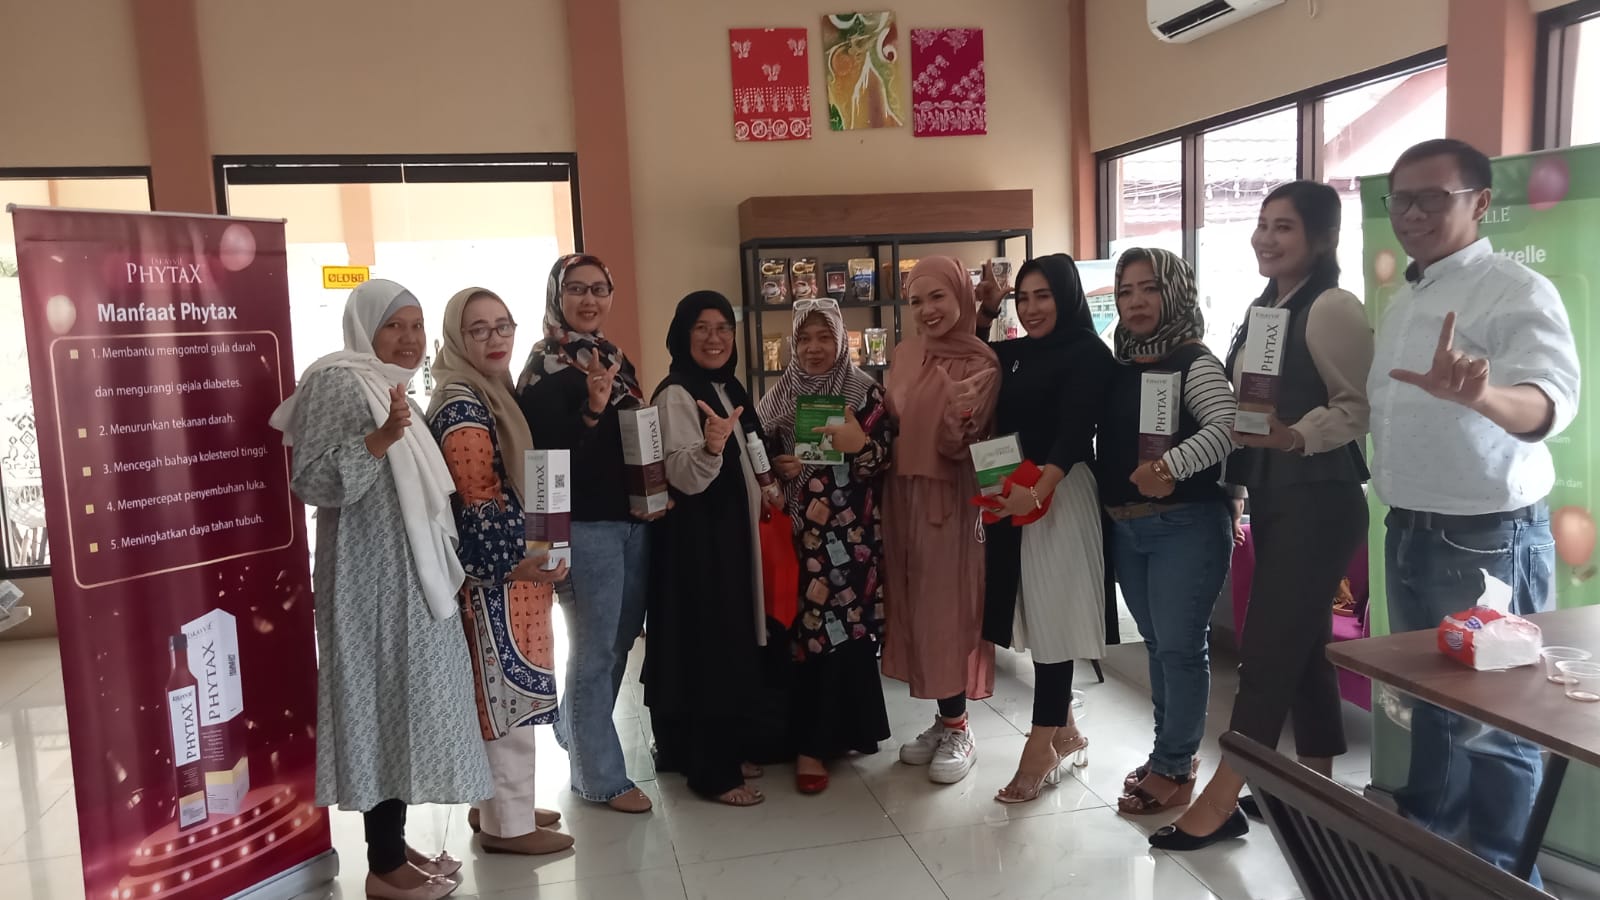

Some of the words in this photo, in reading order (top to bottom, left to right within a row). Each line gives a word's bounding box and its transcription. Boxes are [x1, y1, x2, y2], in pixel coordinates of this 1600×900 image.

[125, 262, 203, 284] PHYTAX
[97, 302, 176, 322] Manfaat
[180, 302, 238, 324] Phytax
[92, 348, 100, 359] 1.
[102, 346, 154, 359] Membantu
[157, 343, 209, 358] mengontrol
[210, 343, 230, 356] gula
[231, 342, 256, 352] darah
[1261, 324, 1279, 372] PHYTAX
[95, 386, 114, 398] dan
[116, 382, 174, 398] mengurangi
[176, 381, 202, 394] gejala
[202, 378, 242, 391] diabetes.
[99, 425, 108, 436] 2.
[110, 419, 170, 435] Menurunkan
[172, 416, 207, 429] tekanan
[208, 412, 235, 425] darah.
[1155, 389, 1167, 432] PHYTAX
[650, 420, 660, 460] PHYTAX
[103, 464, 112, 475] 3.
[113, 457, 162, 473] Mencegah
[164, 453, 198, 468] bahaya
[199, 447, 240, 462] kolesterol
[241, 444, 268, 457] tinggi.
[106, 501, 116, 512] 4.
[117, 492, 182, 510] Mempercepat
[184, 484, 244, 503] penyembuhan
[246, 480, 267, 491] luka.
[536, 465, 545, 511] PHYTAX
[110, 539, 119, 550] 5.
[121, 528, 187, 548] Meningkatkan
[189, 524, 210, 537] daya
[211, 519, 234, 531] tahan
[235, 513, 264, 526] tubuh.
[201, 639, 221, 721] PHYTAX
[181, 702, 197, 760] PHYTAX
